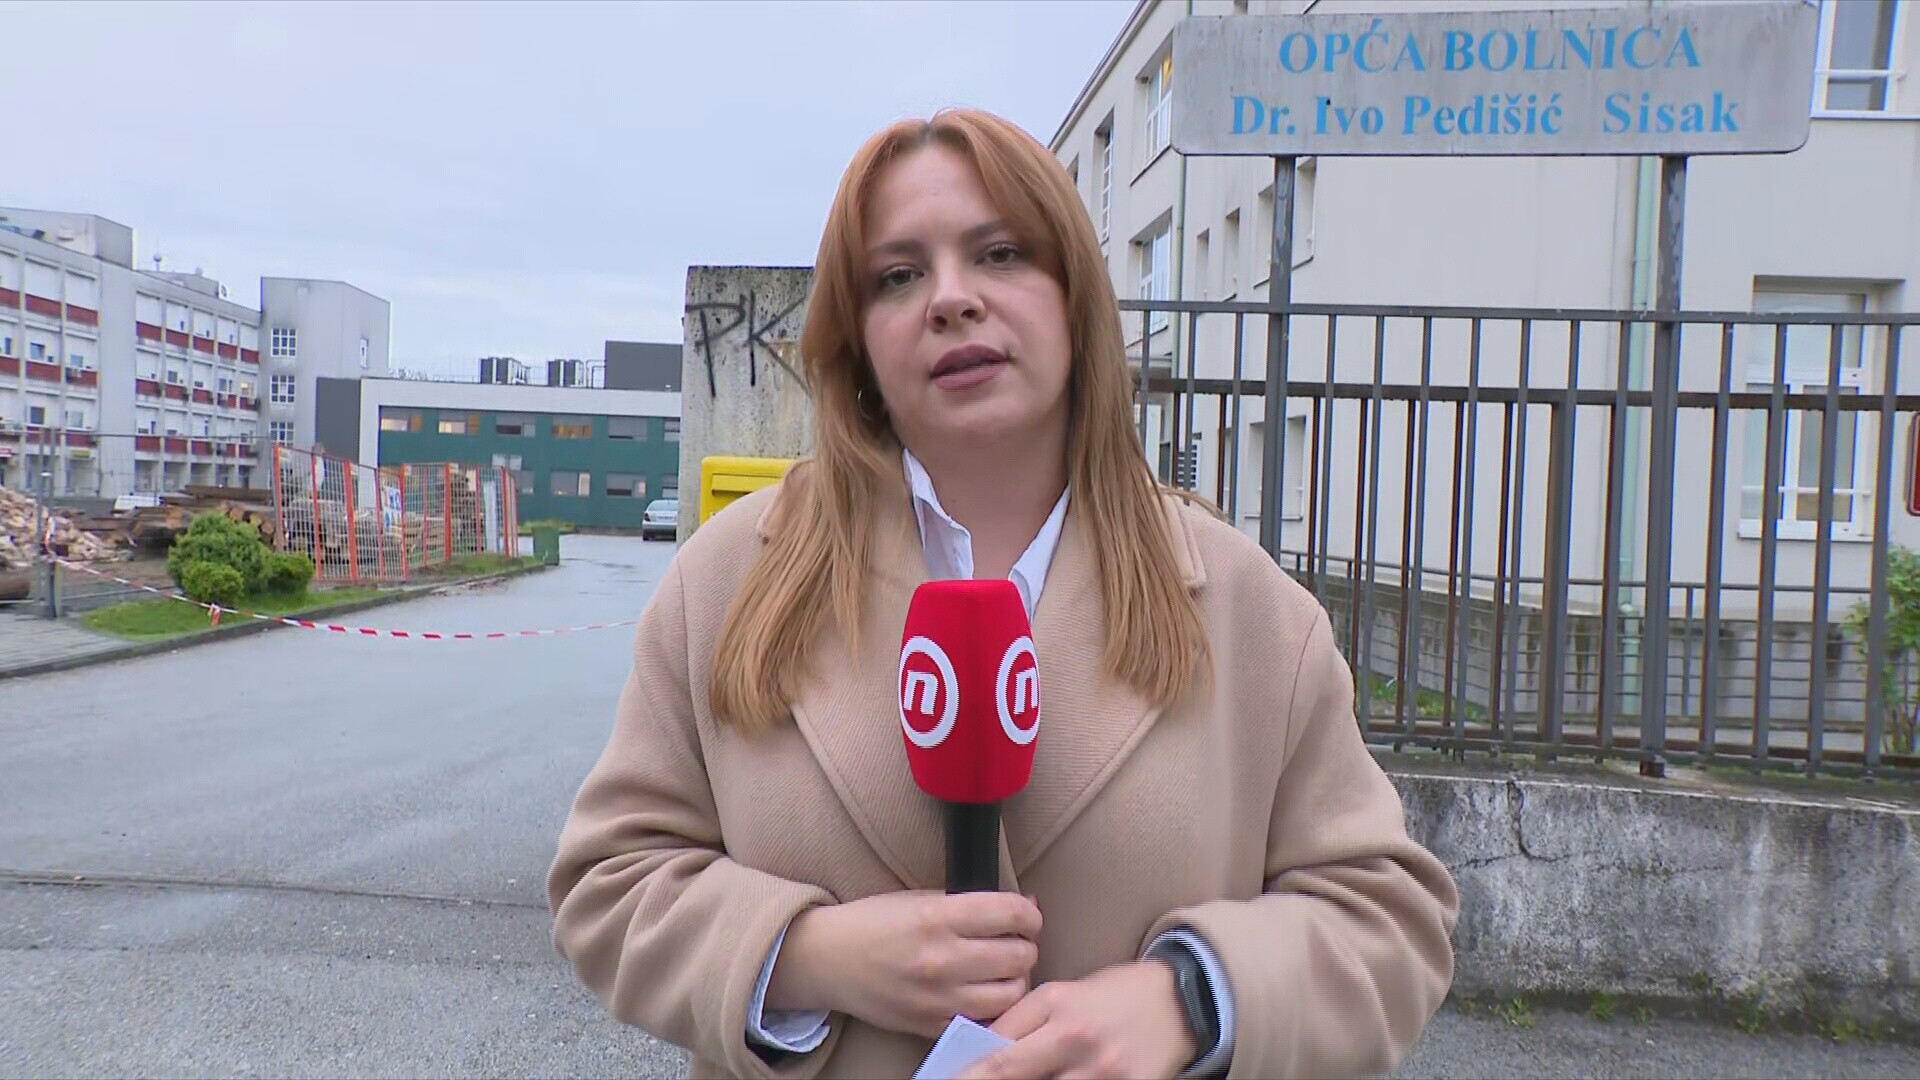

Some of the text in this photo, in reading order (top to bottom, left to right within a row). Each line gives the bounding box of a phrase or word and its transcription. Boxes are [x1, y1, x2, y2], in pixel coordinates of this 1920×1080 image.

[1279, 18, 1702, 74] OPĆA BOLNICA
[1230, 90, 1739, 136] Dr. Ivo Pedišić Sisak
